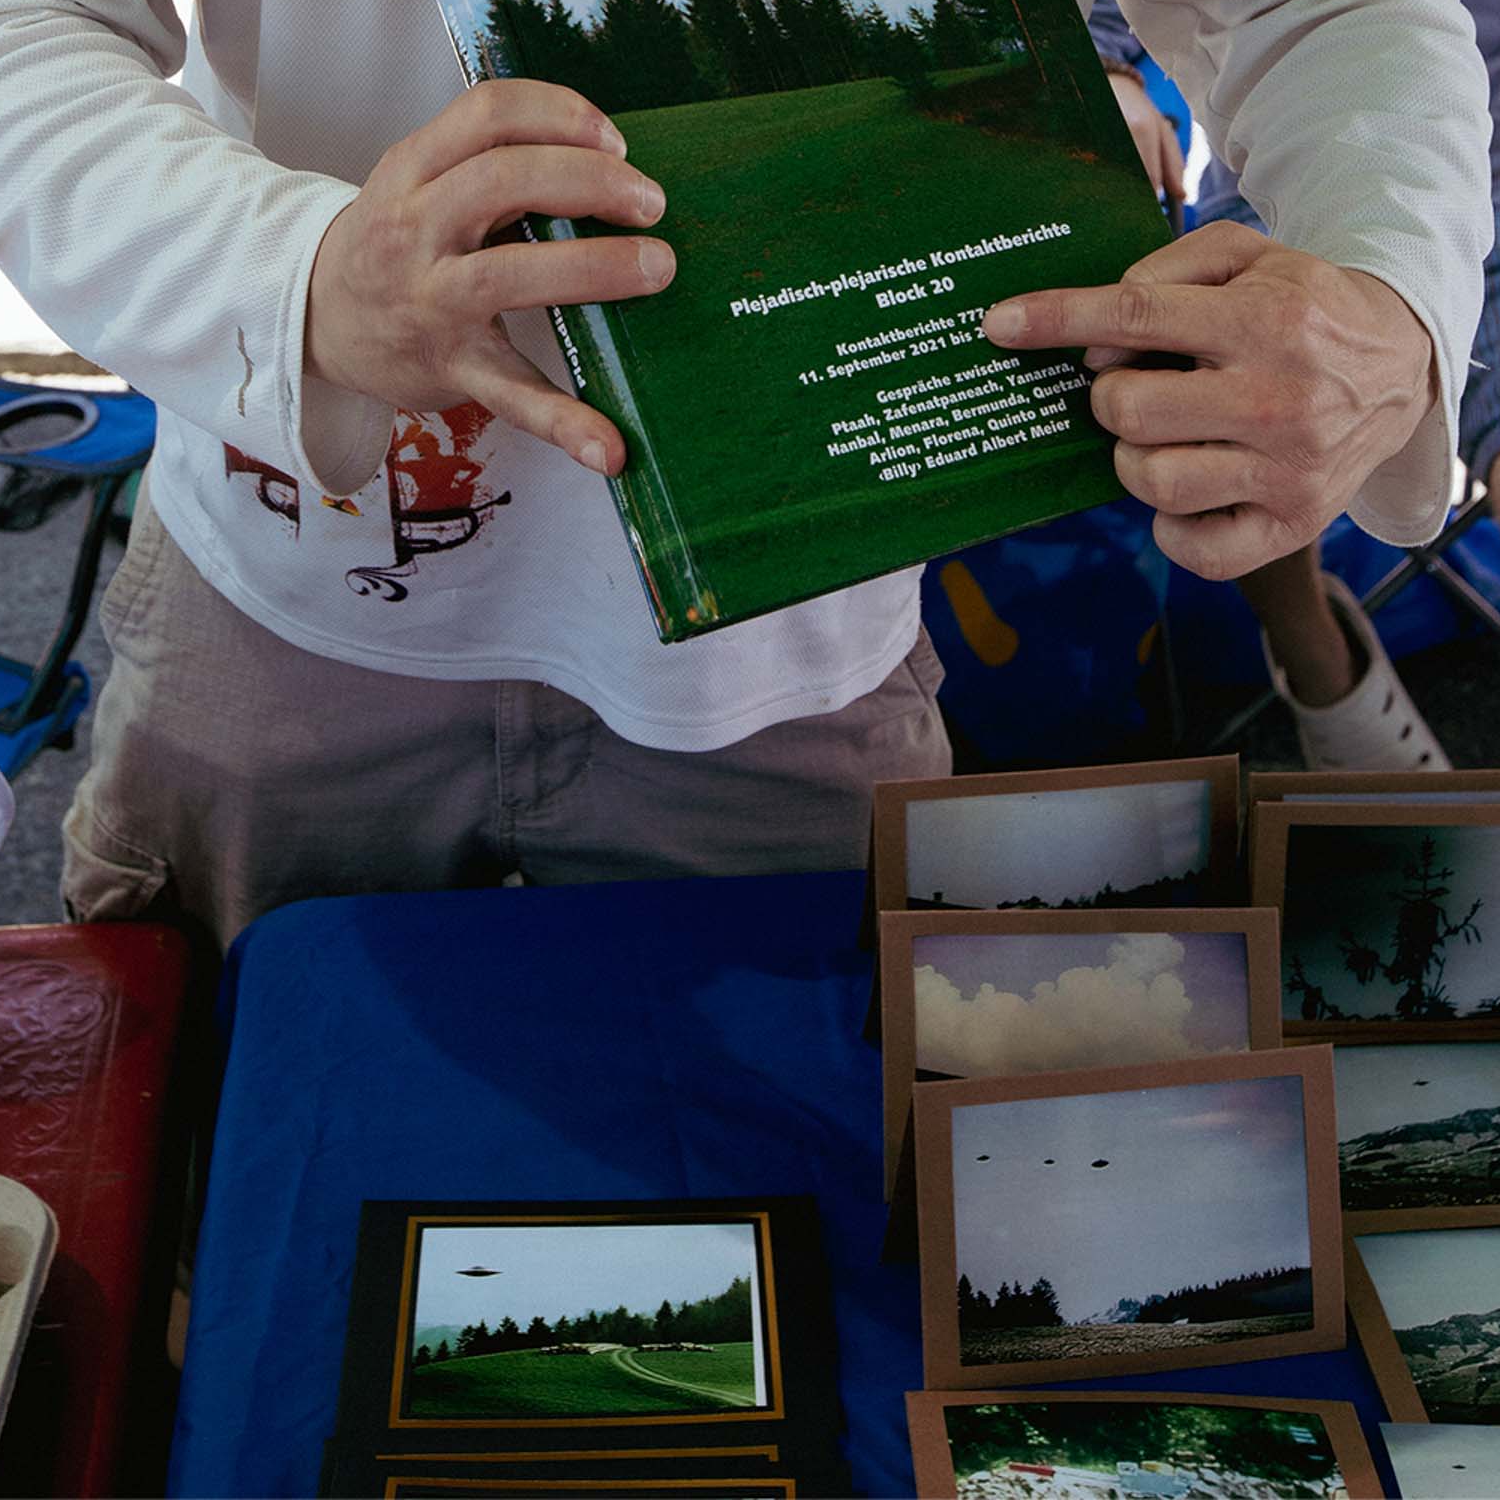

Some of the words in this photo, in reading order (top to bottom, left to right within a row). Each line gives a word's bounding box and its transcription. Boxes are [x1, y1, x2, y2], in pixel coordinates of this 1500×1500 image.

[729, 257, 927, 318] Plejadisch-plejarische
[929, 222, 1072, 268] Kontaktberichte
[875, 282, 928, 309] Block
[929, 276, 955, 295] 20
[798, 370, 825, 385] 11.
[826, 349, 907, 378] September
[908, 336, 947, 357] 2021
[949, 330, 973, 346] bis
[835, 317, 956, 357] Kontaktberichte
[831, 412, 881, 436] Ptaah,
[882, 379, 1004, 421] Zafenatpaneach,
[1005, 362, 1075, 387] Yanarara,
[875, 375, 952, 404] Gespräche
[954, 357, 1021, 382] zwischen
[826, 430, 886, 457] Hanbal,
[888, 415, 950, 440] Menara,
[951, 392, 1031, 422] Bermunda,
[1032, 373, 1091, 399] Quetzal,
[869, 443, 921, 465] Arlion,
[922, 425, 985, 450] Florena,
[986, 409, 1037, 432] Quinto
[1039, 397, 1068, 417] und
[924, 442, 979, 469] Eduard
[981, 429, 1028, 453] Albert
[1029, 419, 1071, 439] Meier
